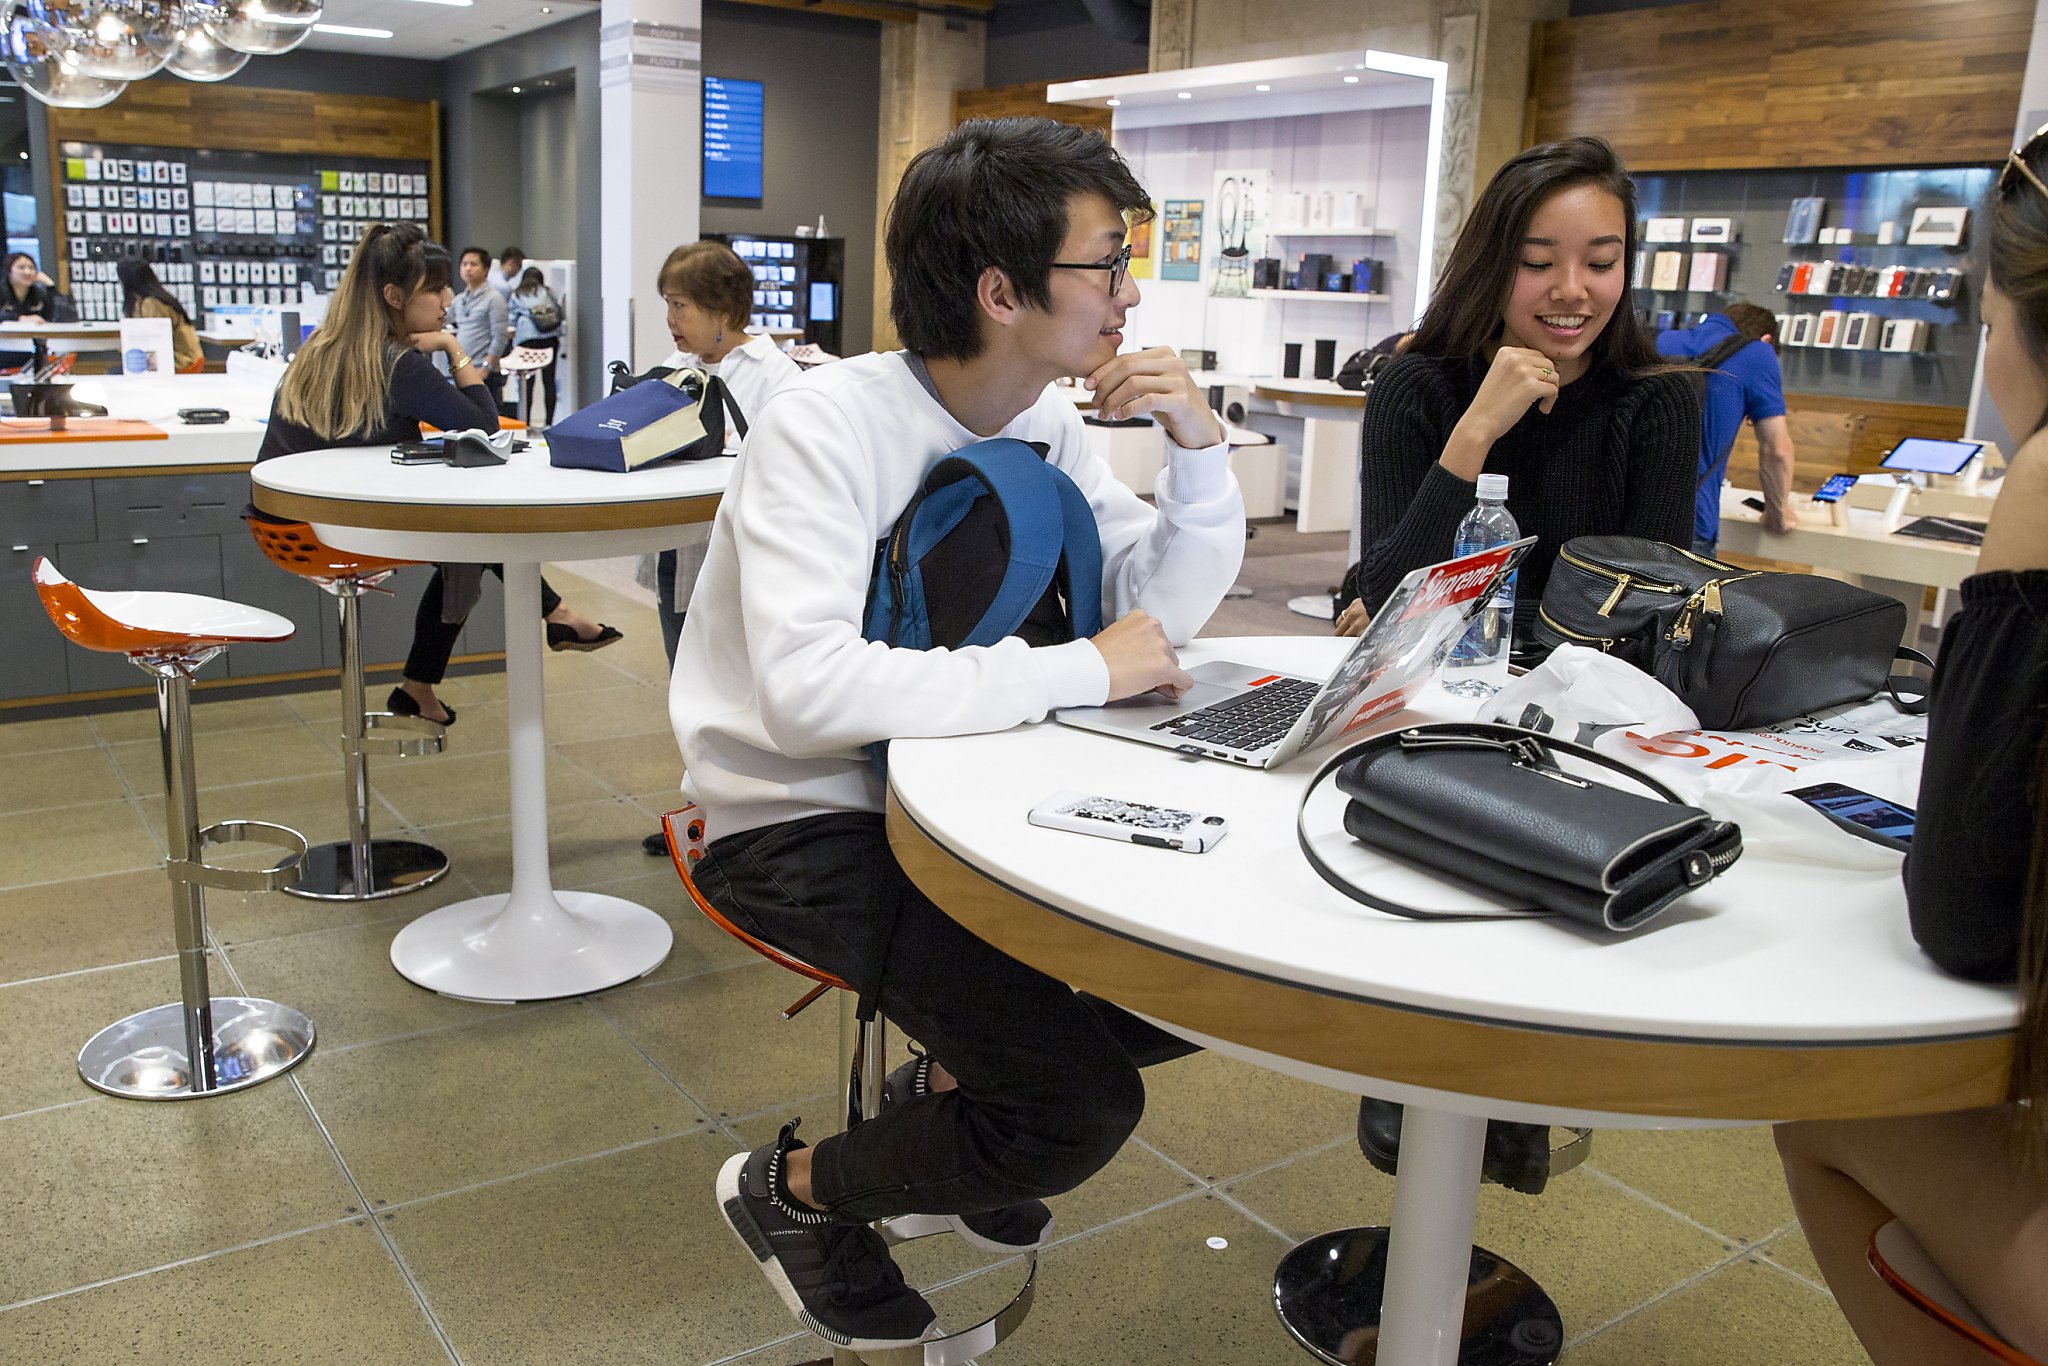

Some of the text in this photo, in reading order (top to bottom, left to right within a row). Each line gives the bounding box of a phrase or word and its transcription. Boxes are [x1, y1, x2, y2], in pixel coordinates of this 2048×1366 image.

[650, 29, 678, 39] FLOOR
[650, 57, 677, 67] FLOOR
[1414, 563, 1498, 609] Supreme
